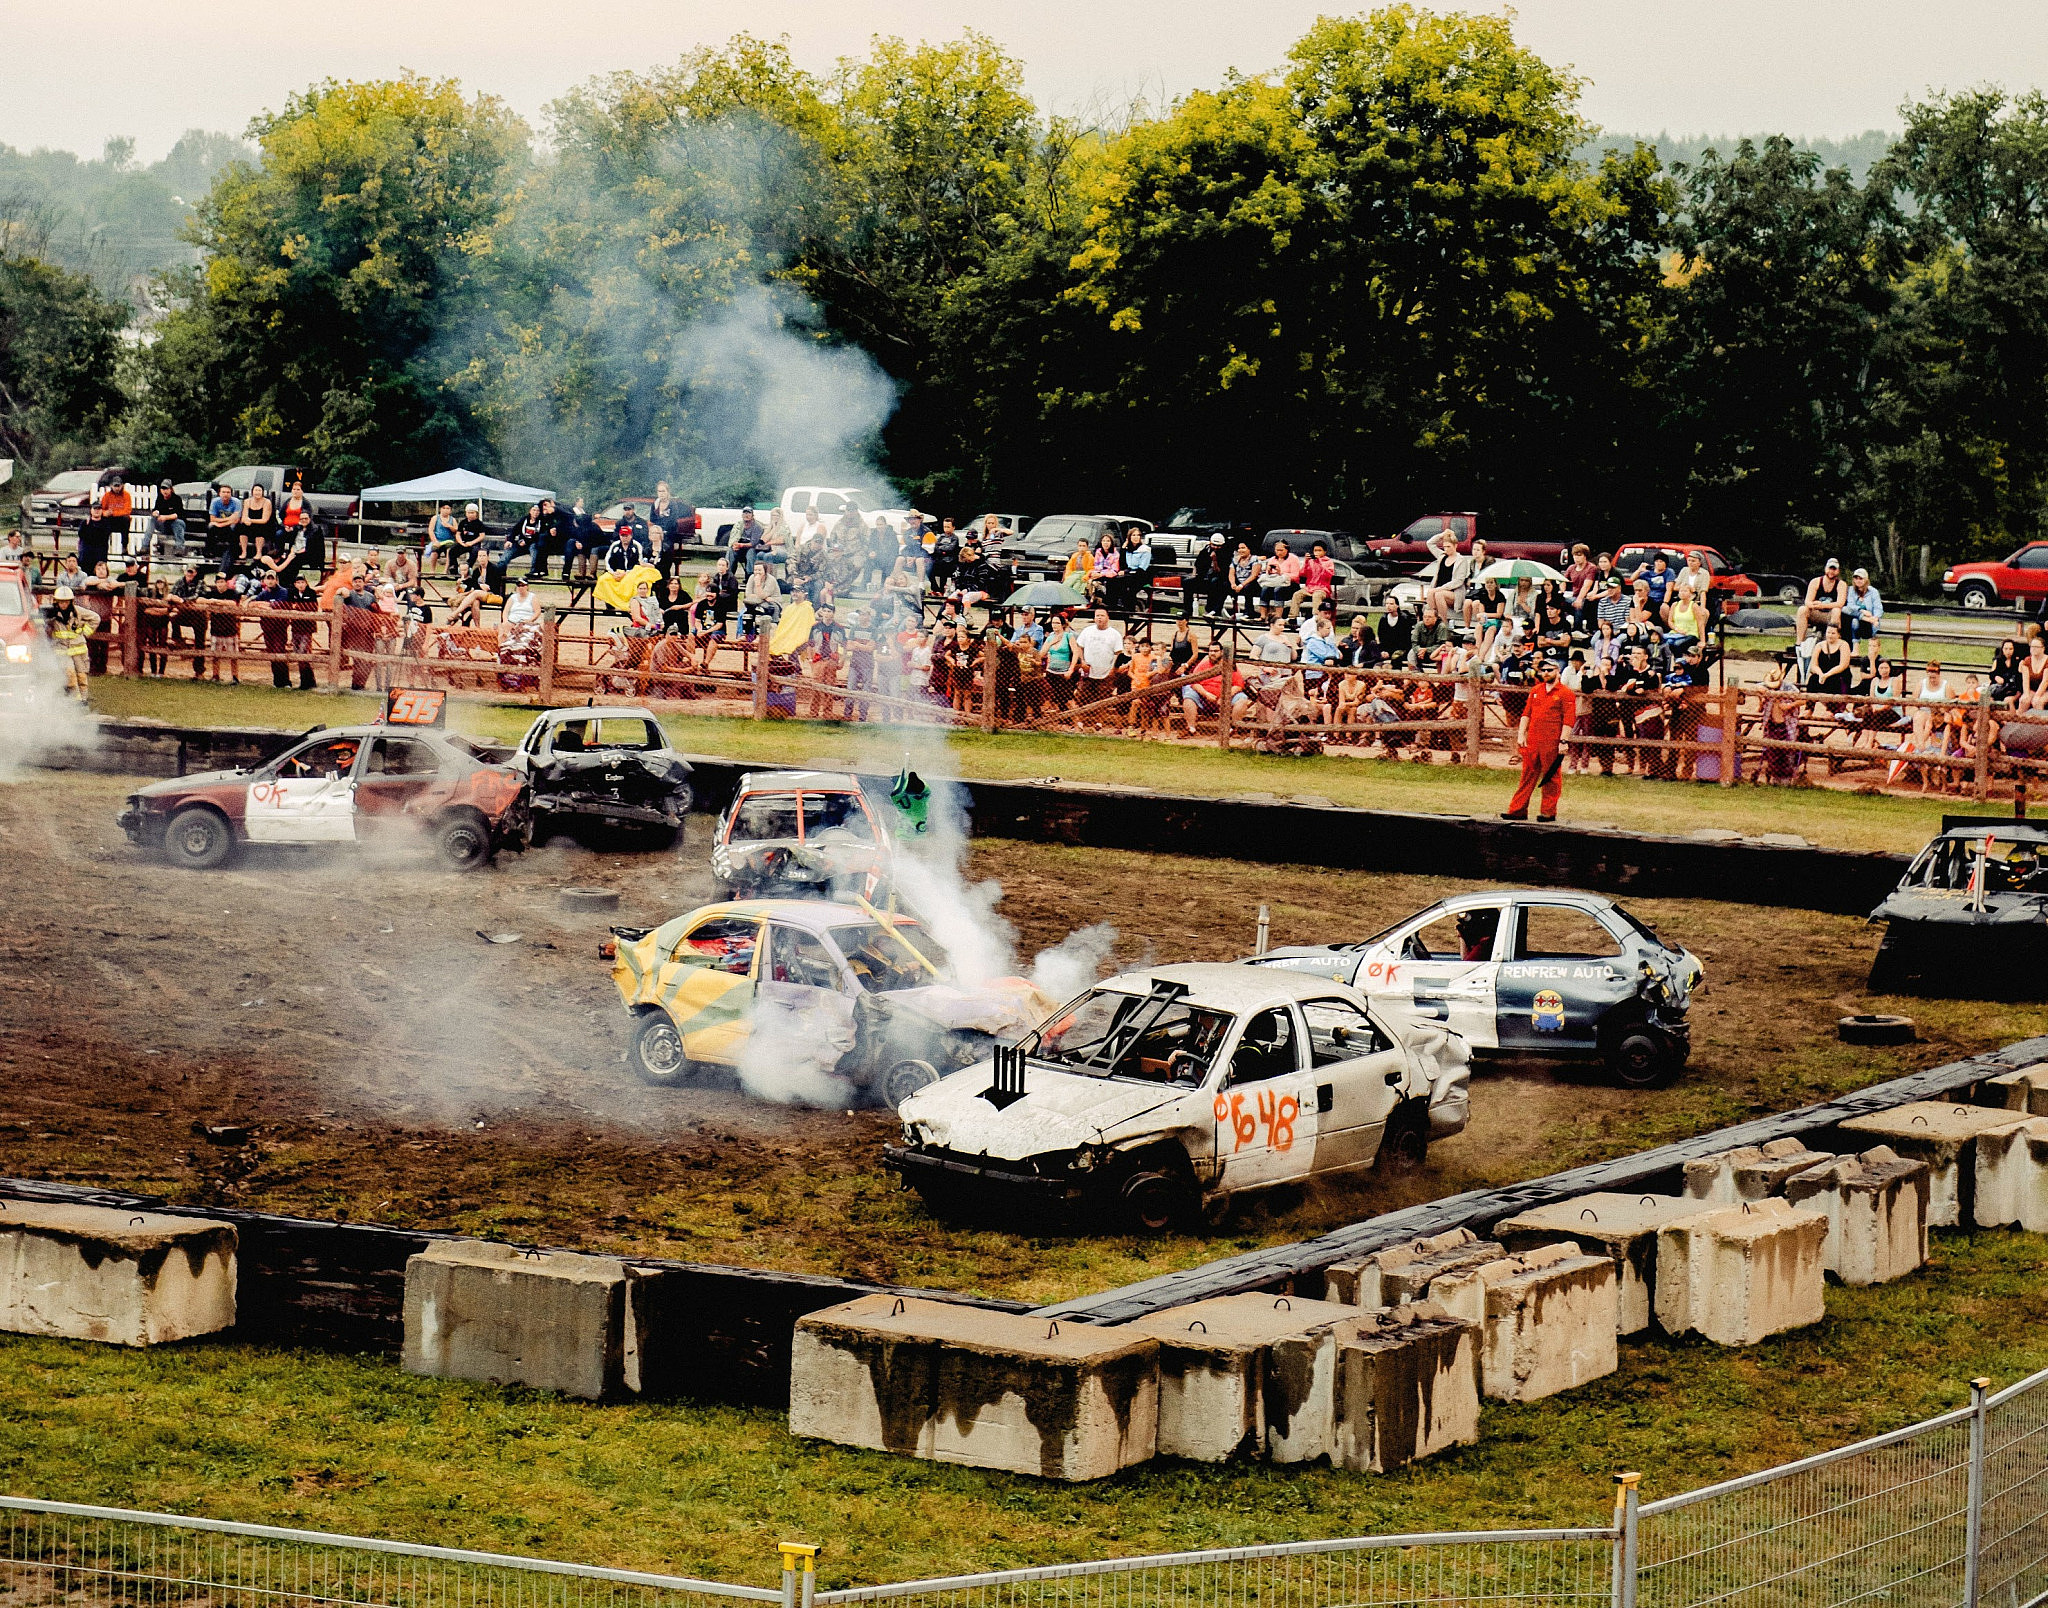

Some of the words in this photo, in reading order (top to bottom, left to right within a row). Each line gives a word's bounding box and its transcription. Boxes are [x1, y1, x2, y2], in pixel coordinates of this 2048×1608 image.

[389, 695, 442, 723] 515
[253, 784, 287, 809] OK
[1310, 957, 1351, 967] AUTO
[1503, 964, 1567, 979] RENFREW
[1573, 965, 1614, 979] AUTO
[1413, 976, 1450, 1022] 5
